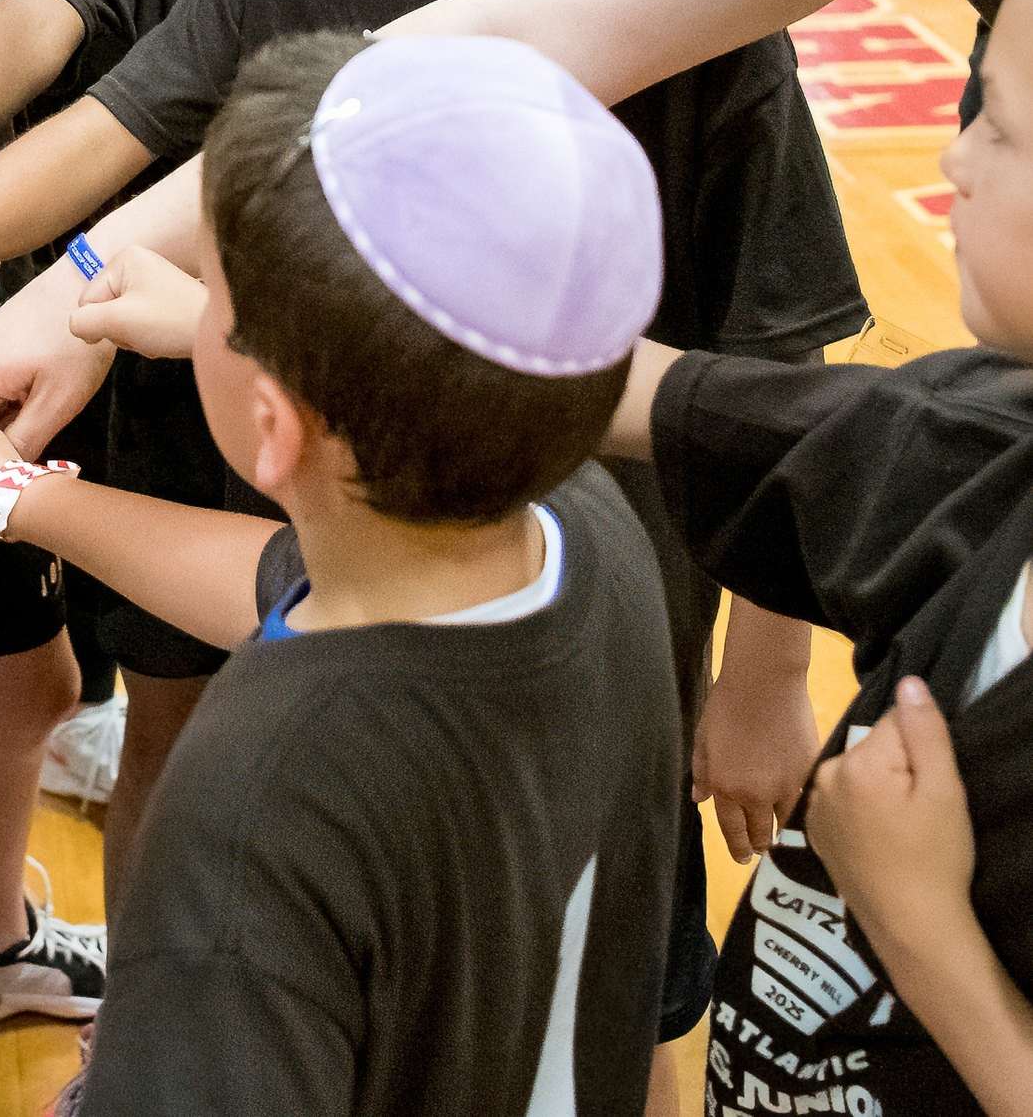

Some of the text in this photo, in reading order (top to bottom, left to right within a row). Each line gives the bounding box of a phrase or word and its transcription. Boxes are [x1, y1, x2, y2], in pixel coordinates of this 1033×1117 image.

[765, 886, 844, 935] KATZ
[763, 938, 820, 982] CHERRY
[764, 985, 805, 1022] 2025
[737, 1071, 883, 1117] JUNIO
